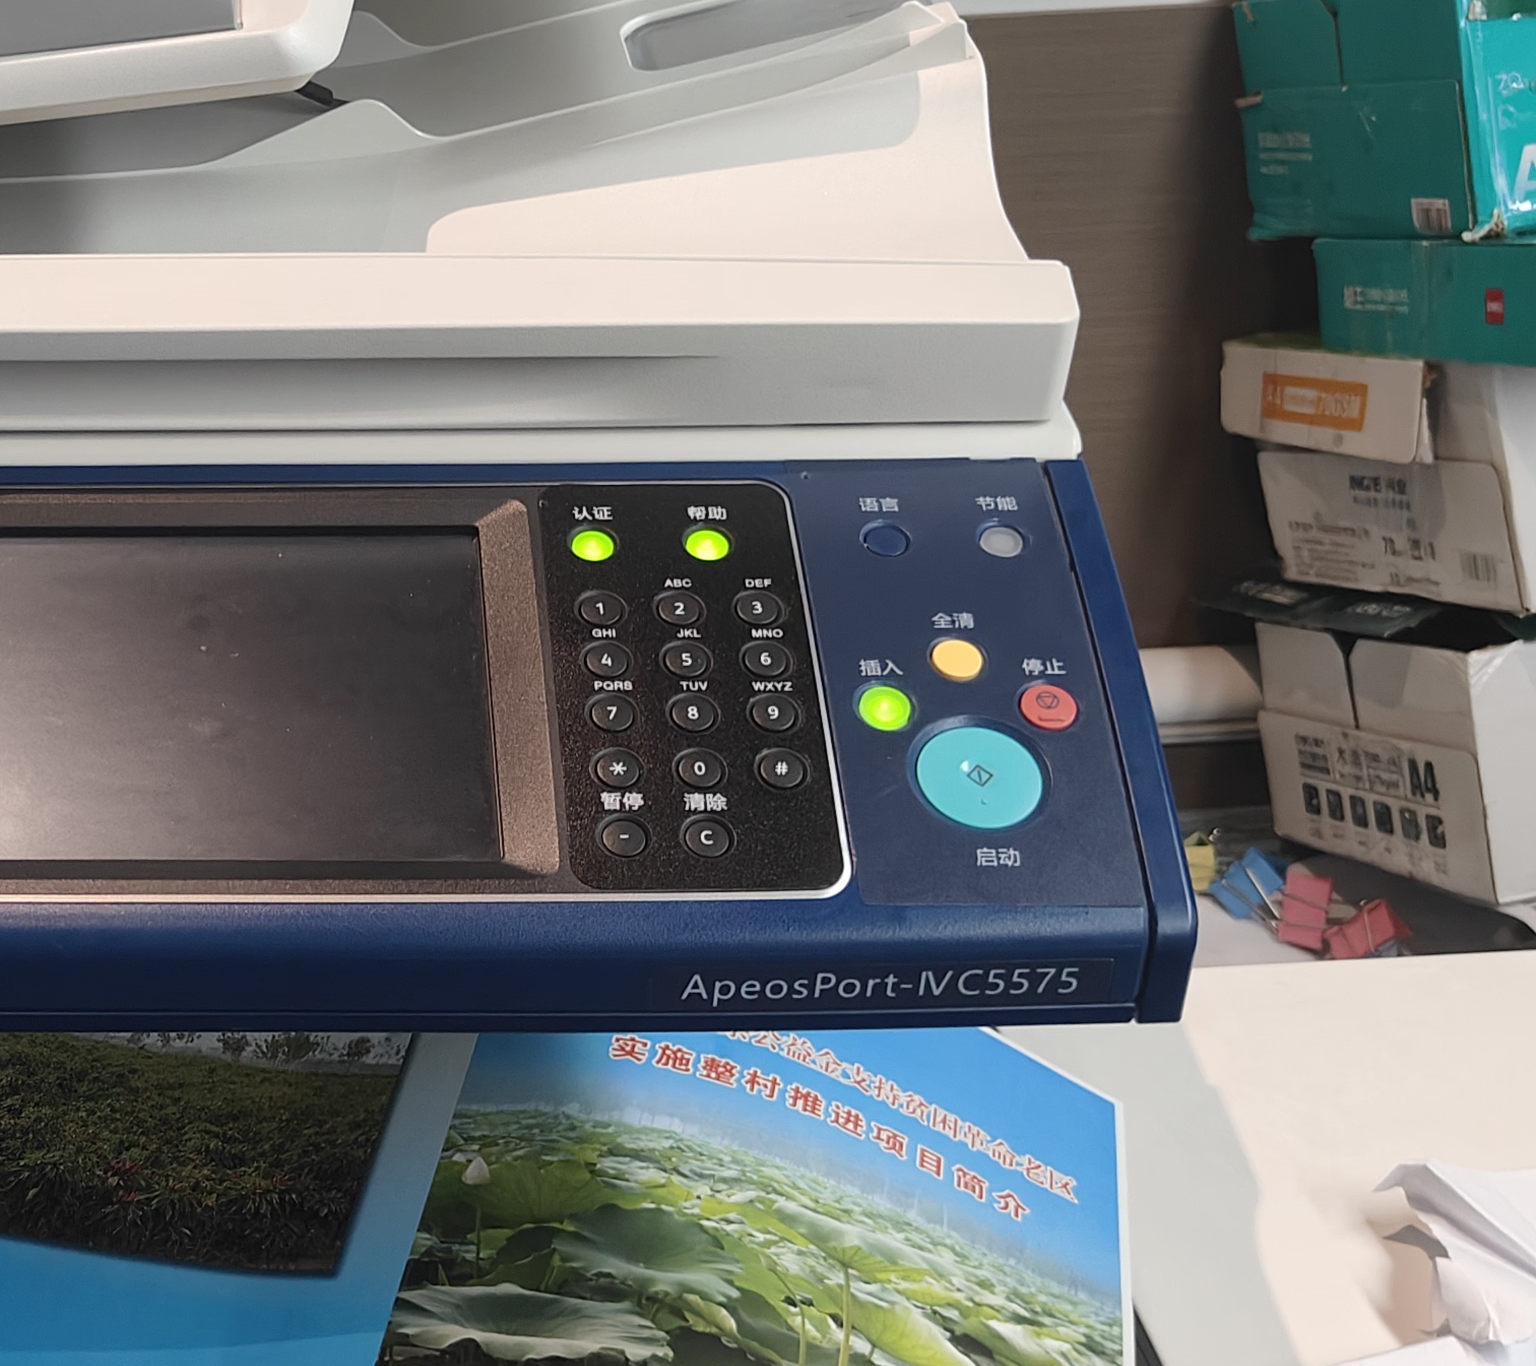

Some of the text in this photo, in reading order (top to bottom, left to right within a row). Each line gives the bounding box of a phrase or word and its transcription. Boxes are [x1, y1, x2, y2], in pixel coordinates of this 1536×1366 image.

[859, 497, 899, 512] 语言
[975, 496, 1018, 511] 节能
[572, 506, 613, 521] 认证
[687, 506, 727, 521] 帮助
[664, 578, 692, 588] ABC
[745, 578, 771, 588] DEF
[595, 602, 604, 615] 1
[674, 602, 685, 615] 2
[751, 601, 763, 614] 3
[931, 613, 974, 629] 全清
[592, 628, 616, 638] GHI
[676, 628, 701, 638] JKL
[751, 628, 783, 638] MNO
[601, 653, 612, 666] 4
[681, 653, 692, 666] 5
[760, 652, 771, 666] 6
[859, 659, 903, 676] 插入
[1022, 658, 1066, 675] 停止
[594, 681, 633, 691] PQRS
[680, 681, 708, 691] TUV
[752, 681, 793, 691] WXYZ
[606, 706, 617, 720] 7
[687, 706, 699, 720] 8
[768, 706, 779, 719] 9
[600, 792, 645, 811] 暂停
[683, 792, 728, 812] 清除
[700, 830, 713, 845] C
[976, 847, 1021, 867] 启动
[609, 1034, 1031, 1222] 实施整村推进项目简介
